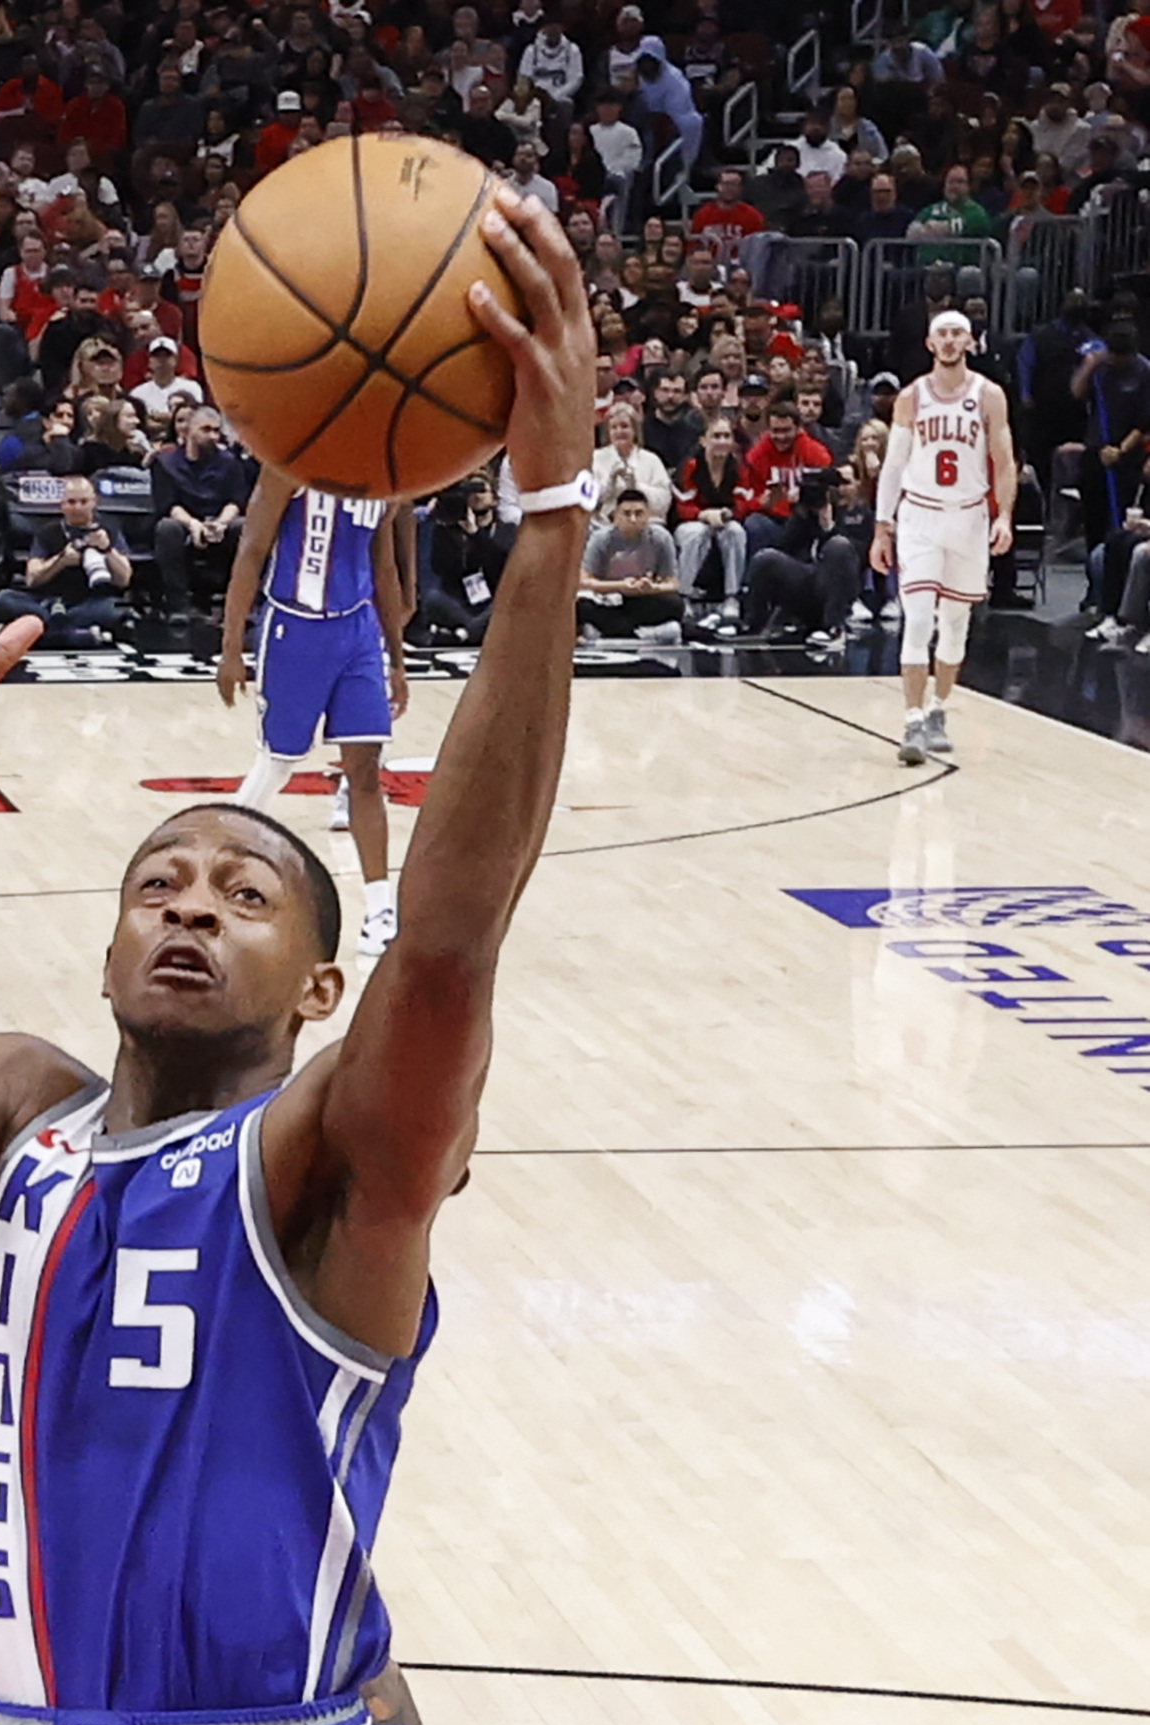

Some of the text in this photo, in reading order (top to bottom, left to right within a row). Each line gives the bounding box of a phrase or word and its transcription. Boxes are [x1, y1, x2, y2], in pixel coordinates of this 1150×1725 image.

[916, 415, 980, 449] BULLS
[935, 450, 958, 487] 6
[305, 493, 327, 575] INGS
[160, 1121, 236, 1171] dpad
[109, 1247, 199, 1391] 5
